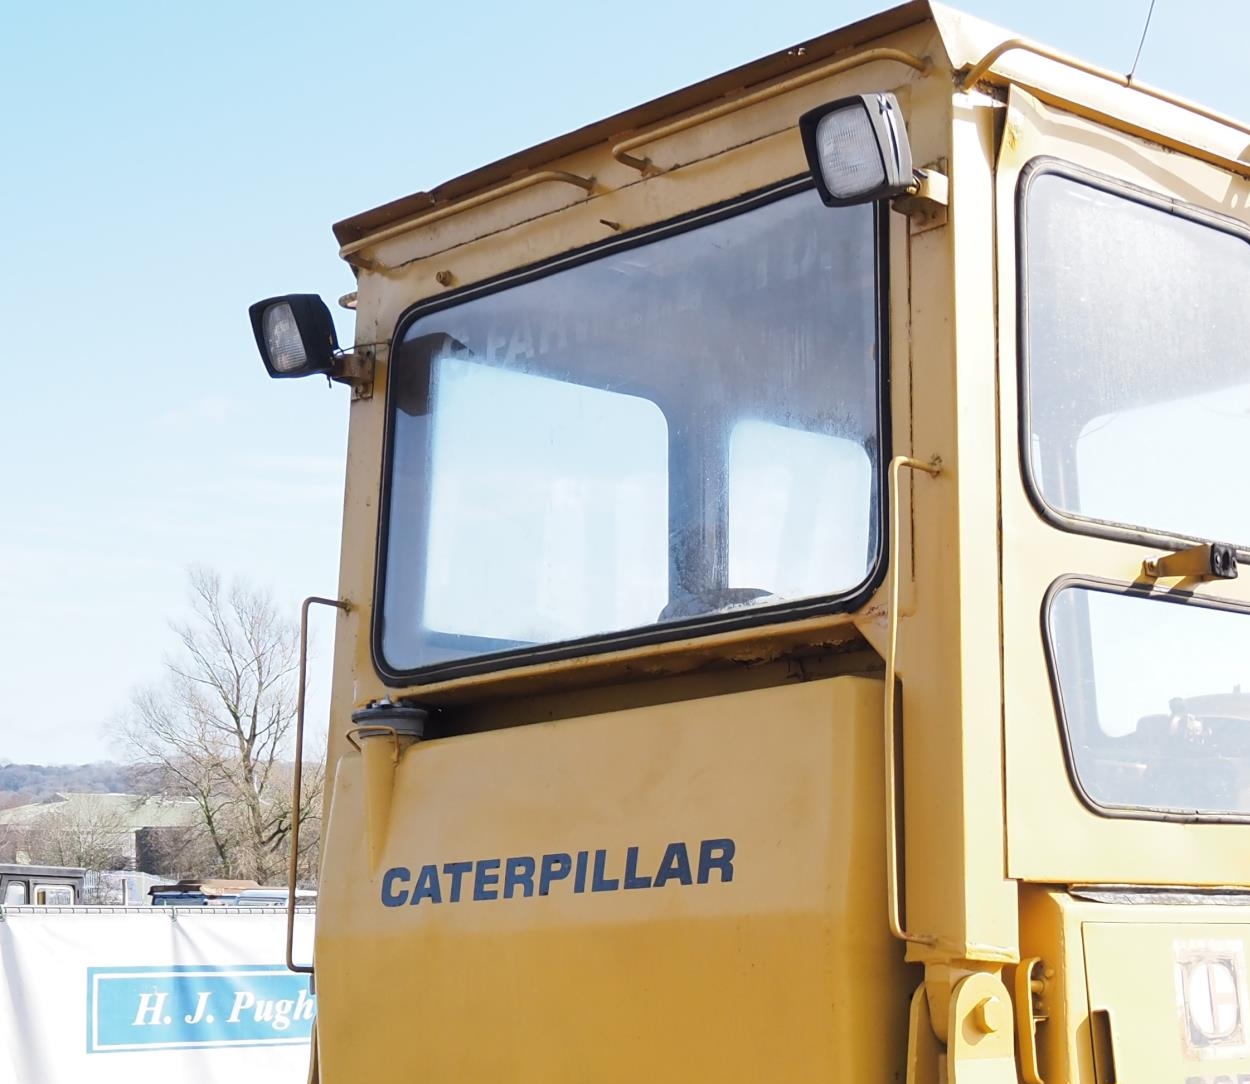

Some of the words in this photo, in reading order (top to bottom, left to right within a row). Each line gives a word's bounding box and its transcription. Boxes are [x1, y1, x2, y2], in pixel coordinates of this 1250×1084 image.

[381, 838, 736, 908] CATERPILLAR
[132, 993, 173, 1026] H.
[184, 991, 215, 1024] J.
[225, 989, 315, 1031] Pugh
